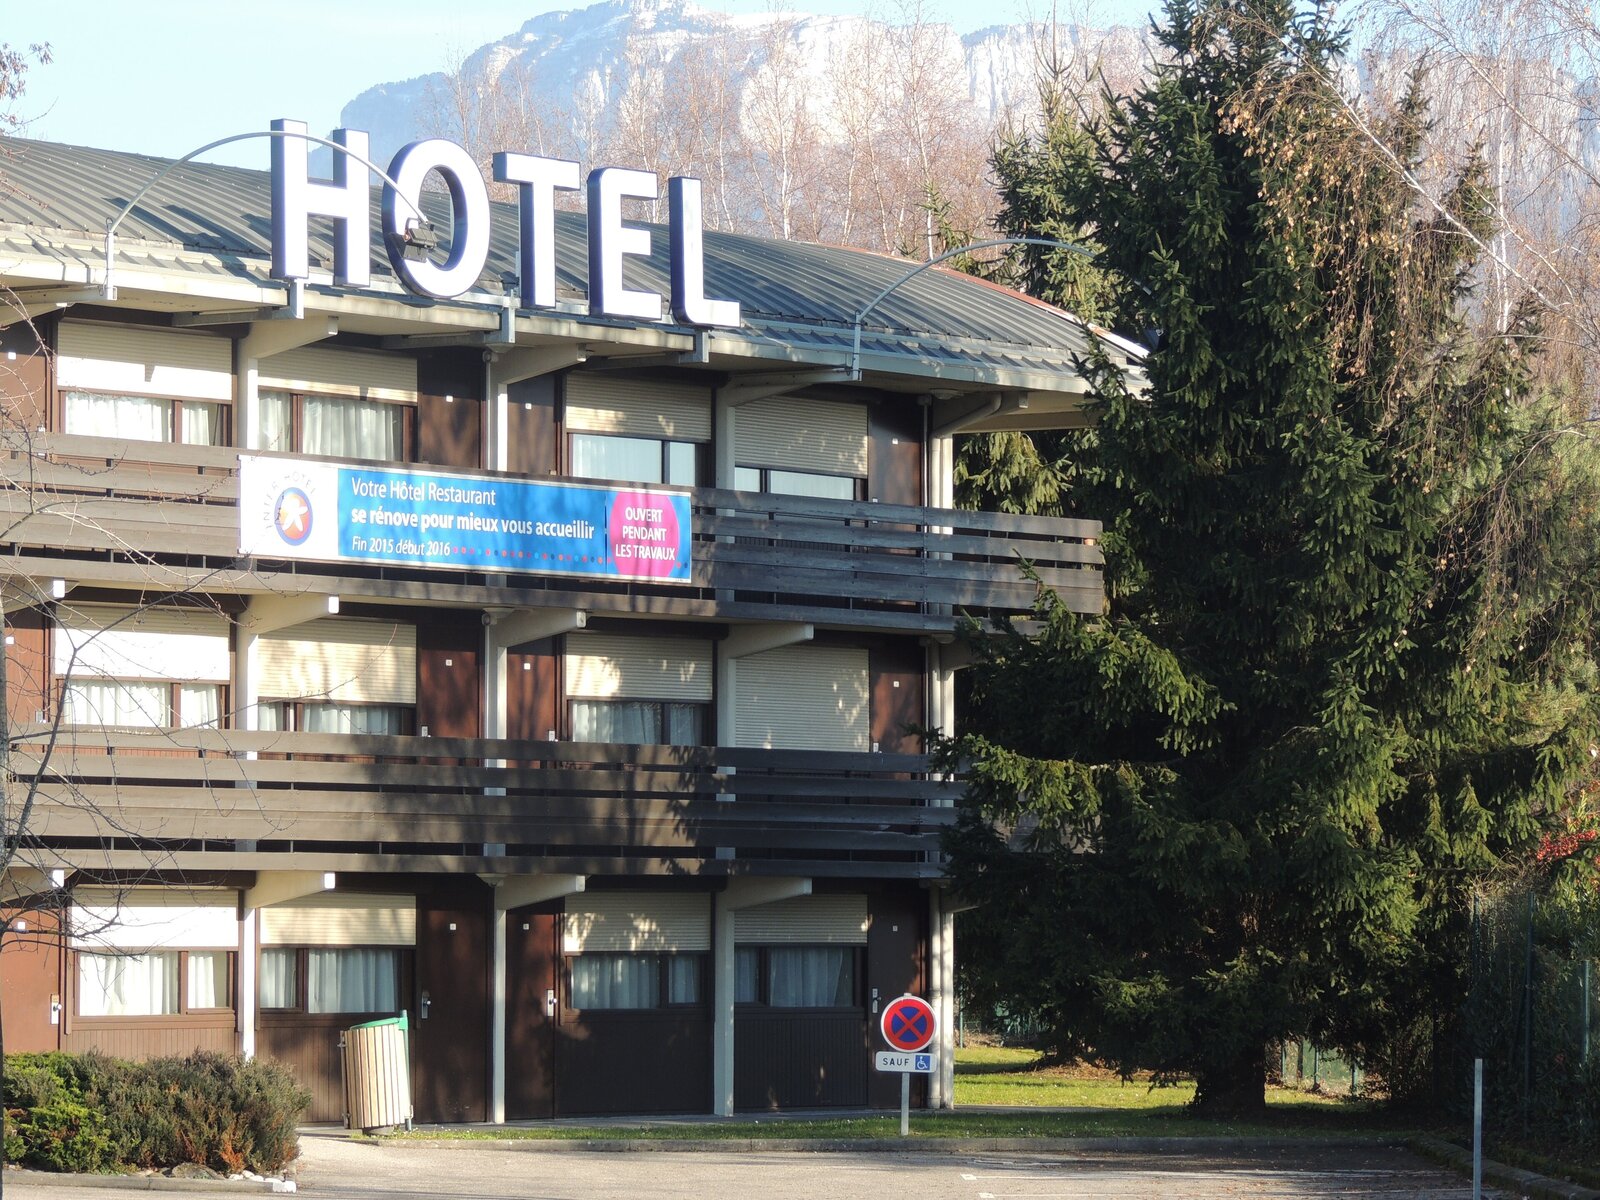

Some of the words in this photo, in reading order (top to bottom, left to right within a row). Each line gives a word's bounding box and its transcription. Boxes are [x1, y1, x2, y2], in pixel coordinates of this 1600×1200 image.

[271, 119, 741, 328] HOTEL
[351, 477, 387, 498] Votre
[390, 480, 426, 501] Hôtel
[428, 482, 496, 506] Restaurant
[351, 507, 367, 523] se
[370, 505, 418, 527] rénove
[421, 513, 454, 533] pour
[457, 511, 499, 532] mieux
[502, 519, 533, 535] vous
[535, 519, 595, 539] accueillir
[625, 506, 663, 522] OUVERT
[622, 525, 667, 542] PENDANT
[352, 535, 367, 551] Fin
[369, 537, 394, 554] 2015
[396, 539, 425, 555] début
[426, 540, 451, 556] 2016
[615, 543, 632, 558] LES
[633, 544, 676, 561] TRAVAUX
[882, 1057, 910, 1067] SAUF
